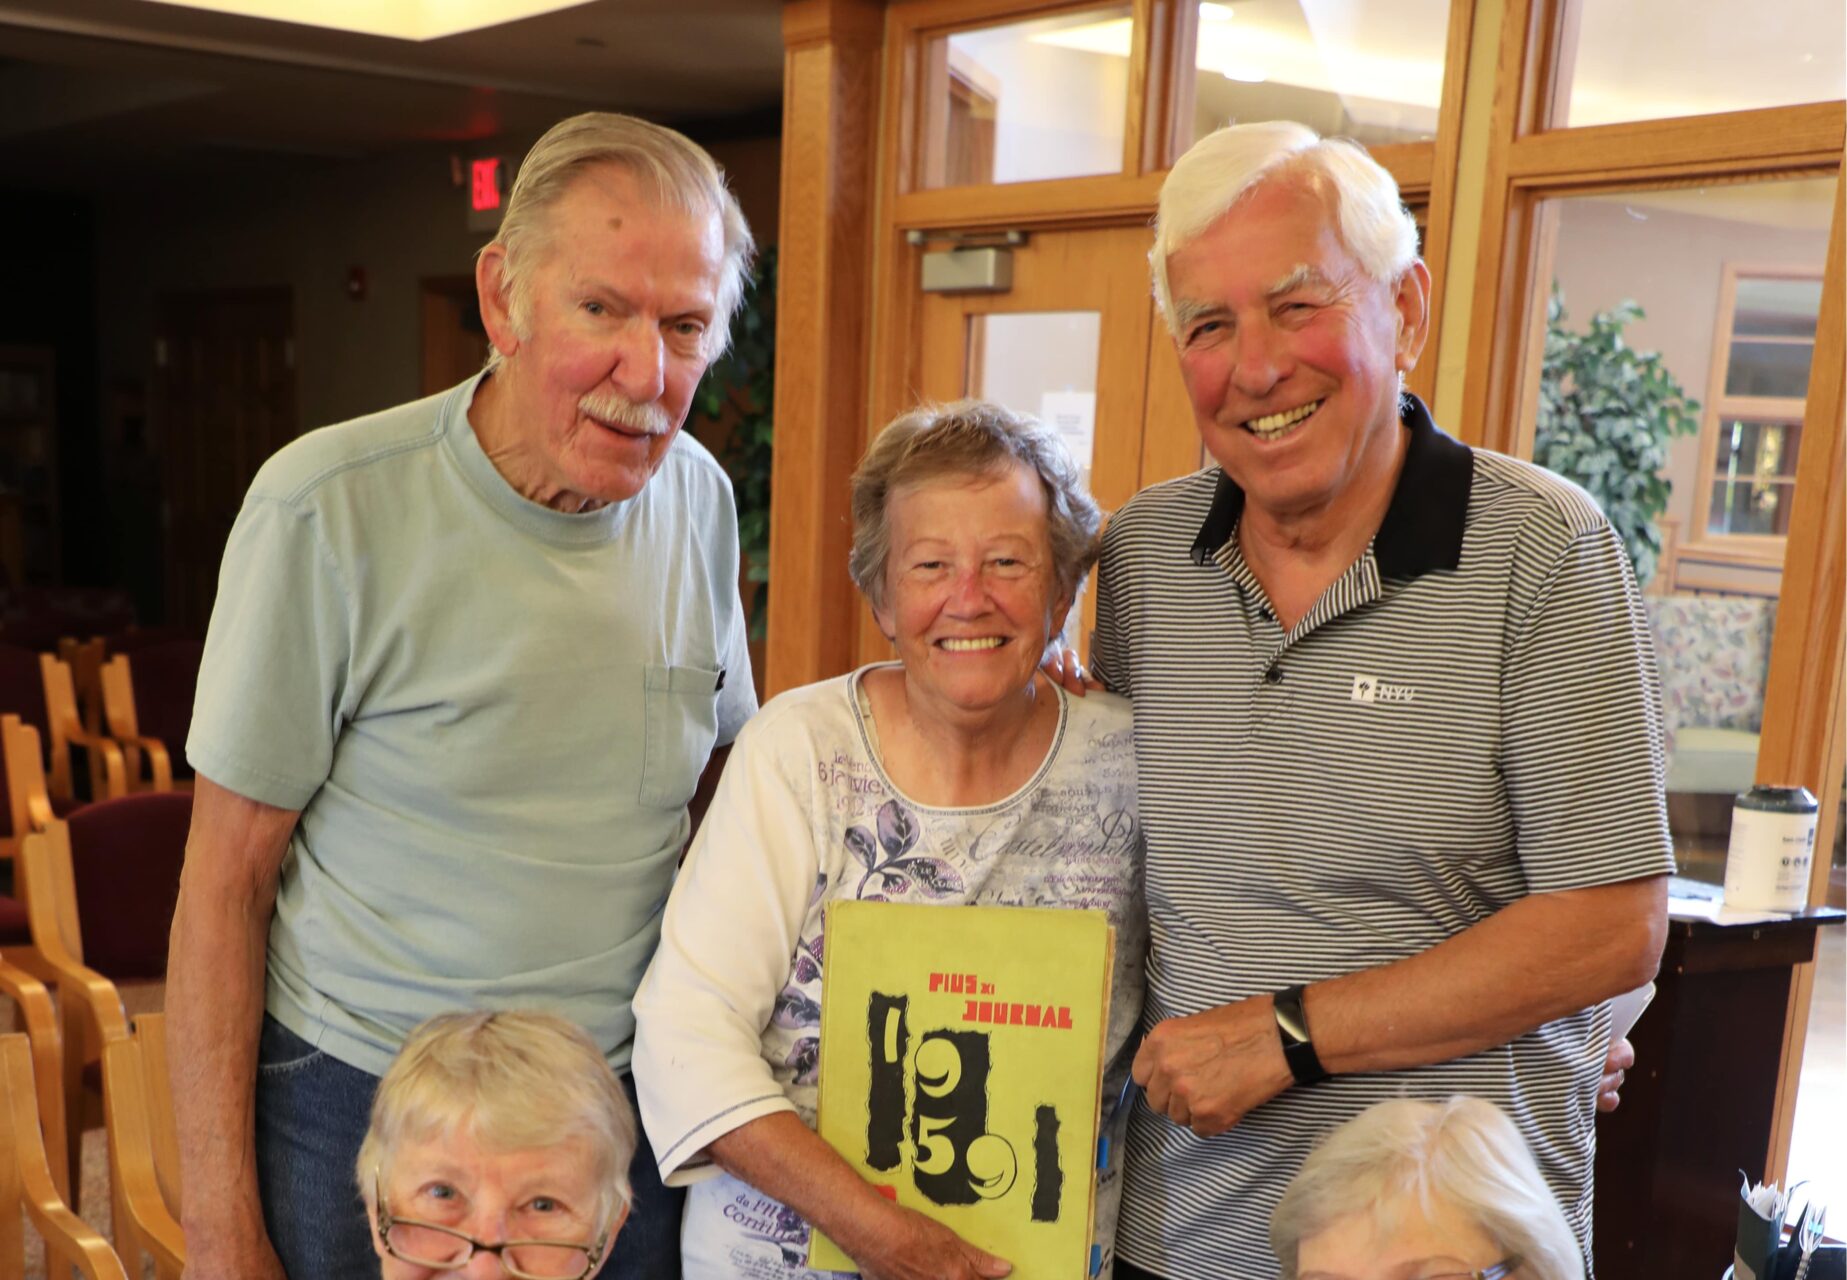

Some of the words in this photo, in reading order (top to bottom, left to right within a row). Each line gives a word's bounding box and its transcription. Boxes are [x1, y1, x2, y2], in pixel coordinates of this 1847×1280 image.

[1379, 683, 1415, 702] NYU
[928, 972, 978, 995] PIUS
[962, 1001, 1073, 1030] JOURNAL
